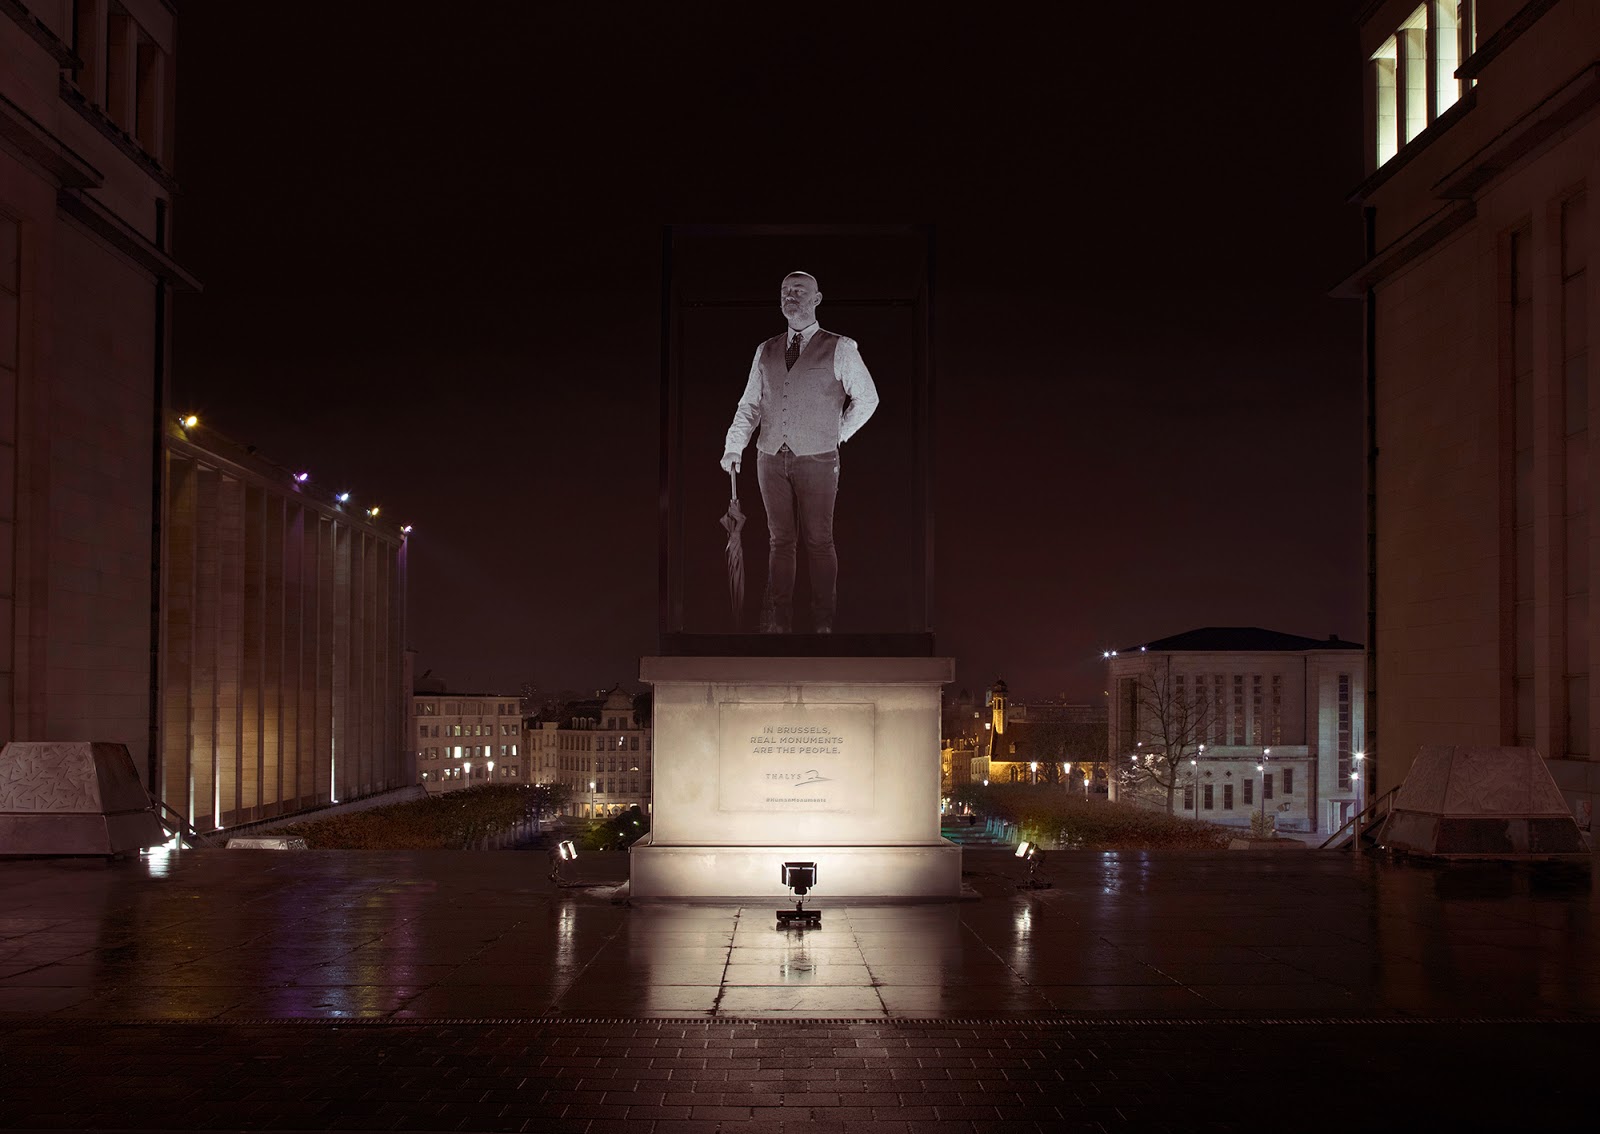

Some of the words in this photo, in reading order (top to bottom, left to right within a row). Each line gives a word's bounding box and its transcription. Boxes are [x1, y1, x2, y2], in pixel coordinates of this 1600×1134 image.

[777, 726, 831, 735] BRUSSELS,
[750, 736, 776, 744] REAL
[779, 736, 844, 744] MONUMENTS
[753, 746, 773, 754] ARE
[776, 746, 796, 754] THE
[799, 746, 841, 754] PEOPLE.
